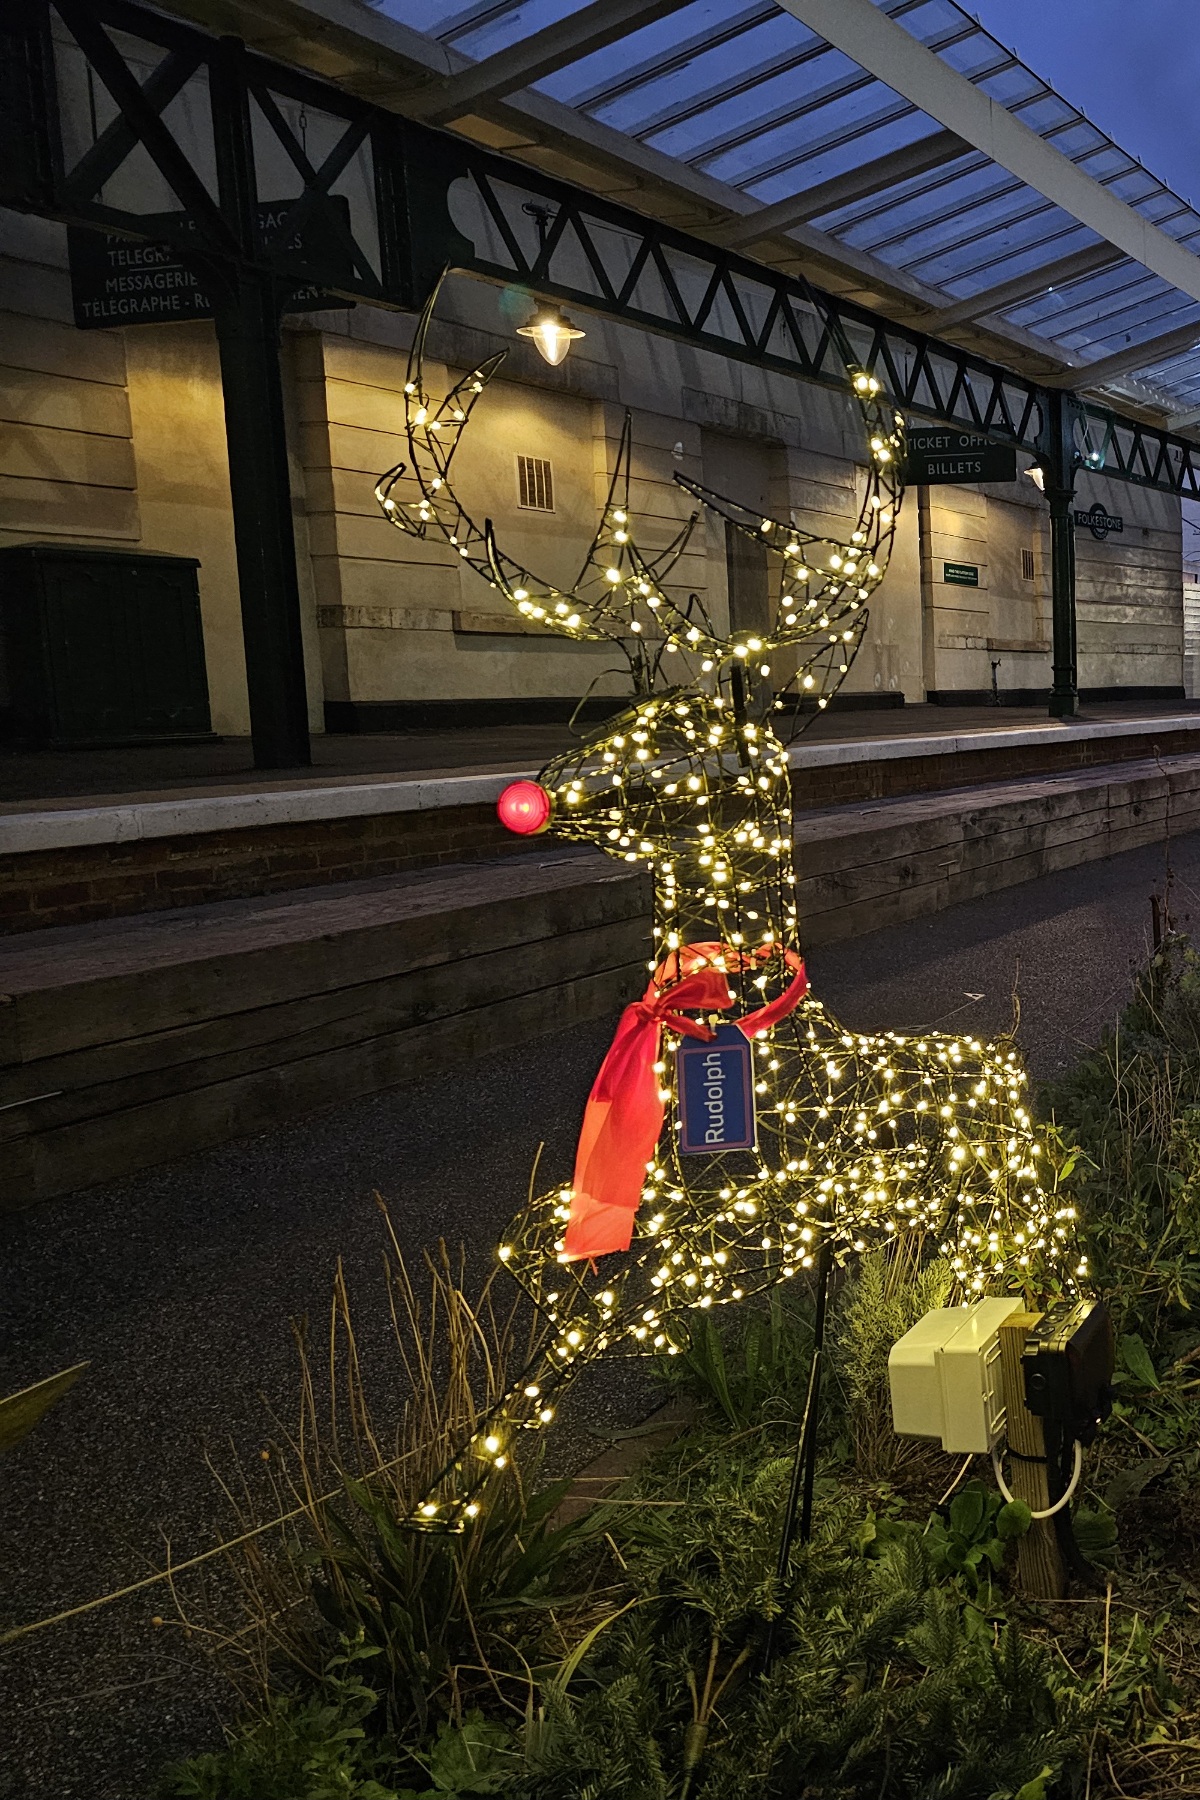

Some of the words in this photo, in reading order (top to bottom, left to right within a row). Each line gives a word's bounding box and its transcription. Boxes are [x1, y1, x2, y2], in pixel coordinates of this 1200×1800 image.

[105, 272, 198, 294] MESSAGERIE
[927, 461, 982, 475] BILLETS
[1077, 512, 1122, 530] FOLKESTONE
[701, 1052, 726, 1144] Rudolph
